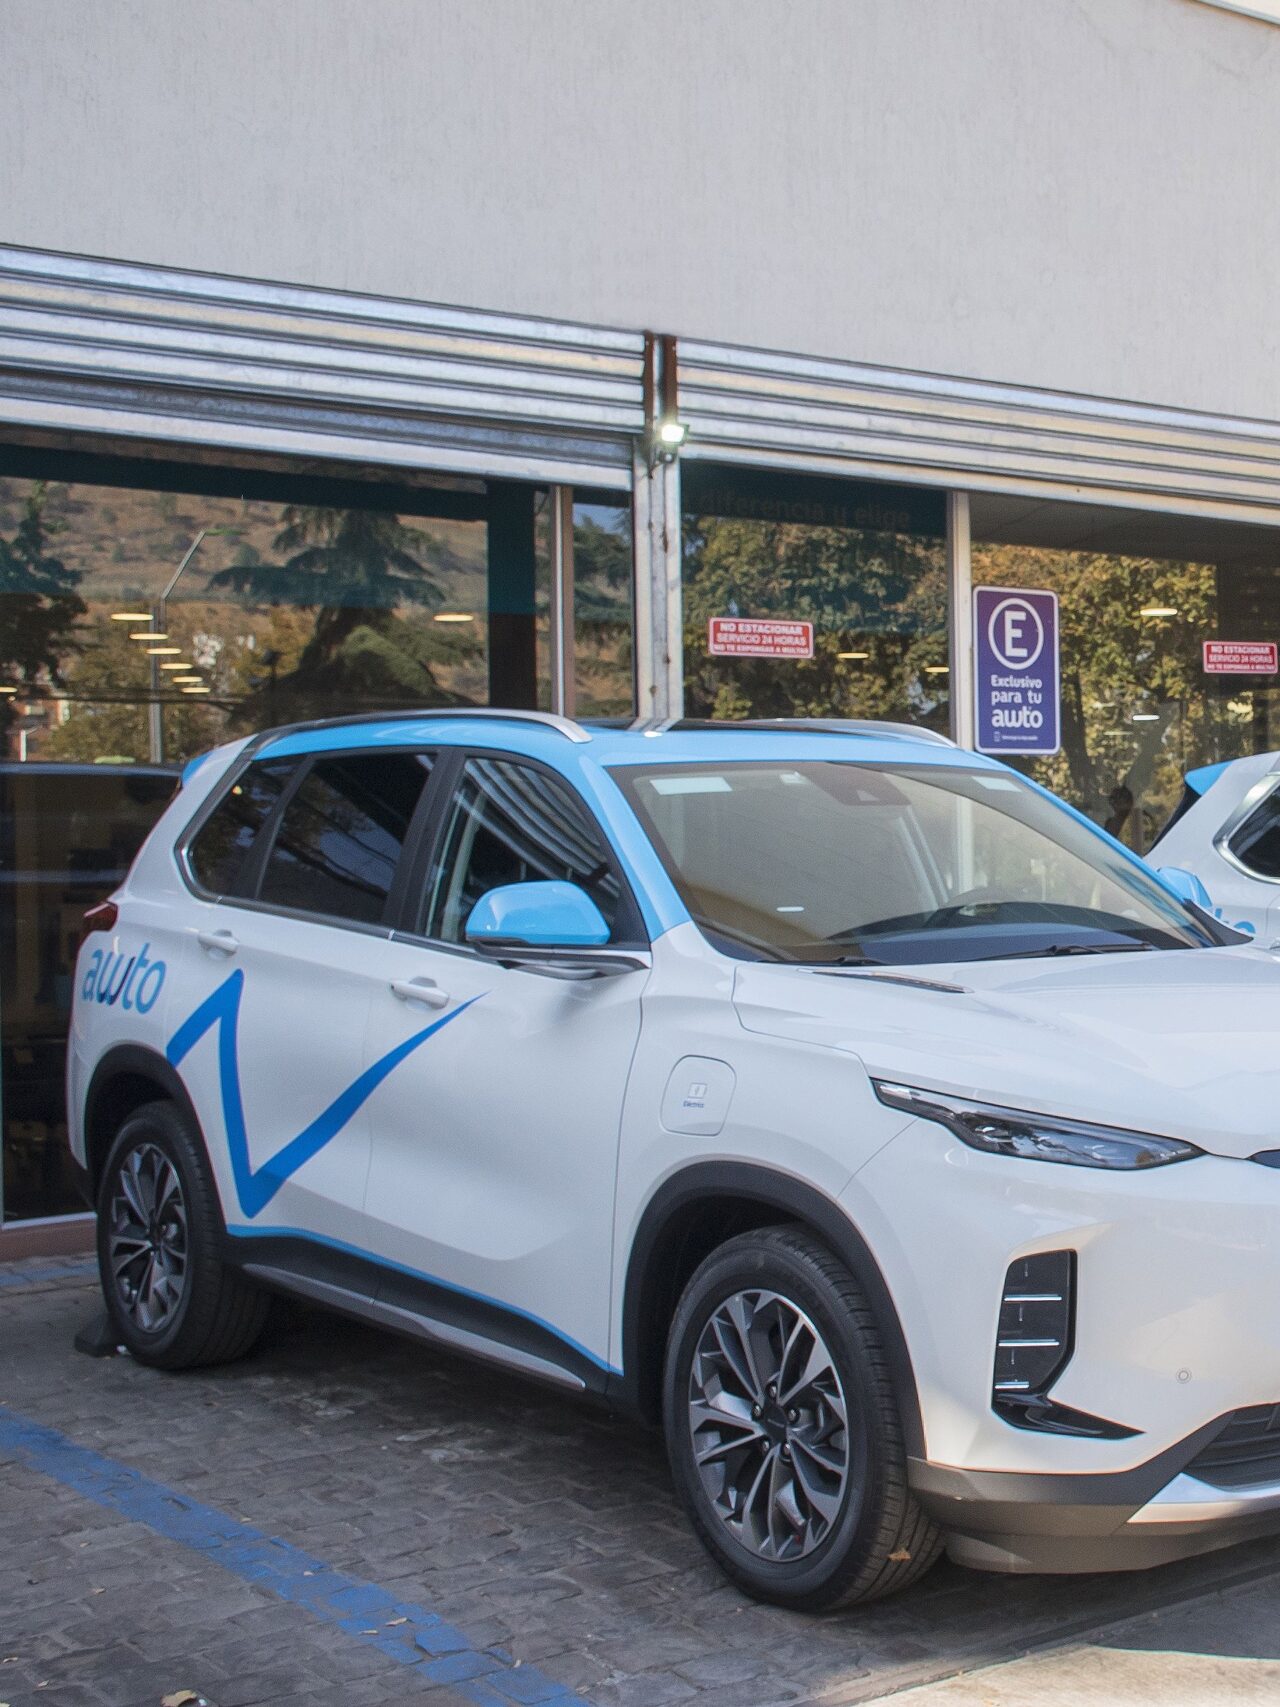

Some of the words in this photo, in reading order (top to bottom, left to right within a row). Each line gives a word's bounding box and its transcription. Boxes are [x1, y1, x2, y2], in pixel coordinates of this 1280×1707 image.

[1004, 610, 1028, 658] E
[991, 675, 1043, 688] Exclusivo
[991, 691, 1022, 706] para
[1028, 690, 1042, 704] tu
